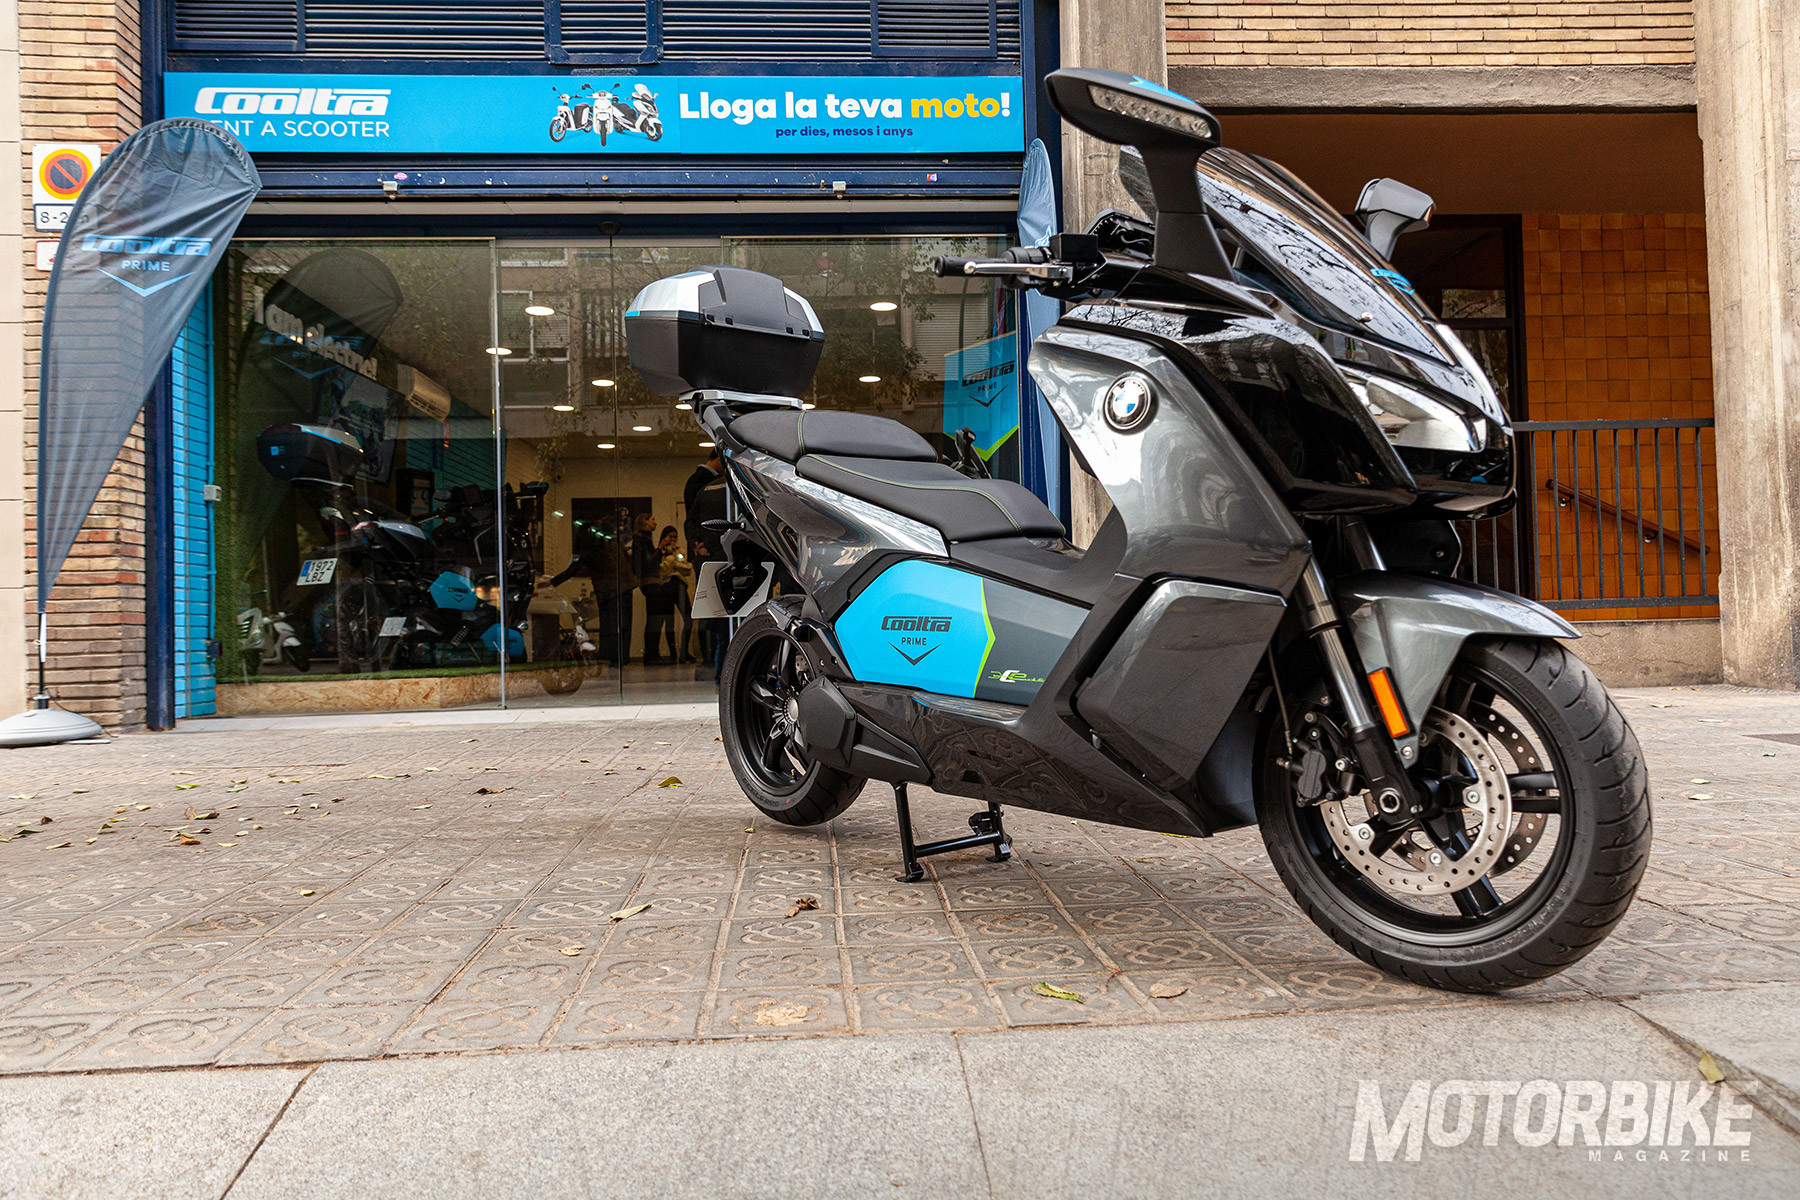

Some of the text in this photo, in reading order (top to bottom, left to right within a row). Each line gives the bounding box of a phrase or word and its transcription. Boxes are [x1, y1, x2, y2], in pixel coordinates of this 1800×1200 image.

[194, 87, 392, 116] Cooltra
[679, 91, 1011, 125] Lloga la teva moto!
[209, 120, 390, 138] NT A SCOOTER
[776, 125, 914, 139] per dies, mesos i anys
[80, 233, 214, 257] Cooltra
[121, 259, 171, 273] PRIME
[961, 359, 1016, 387] Cooltra
[310, 560, 335, 572] 1972
[881, 615, 953, 633] Cooltra
[901, 636, 927, 646] PRIME
